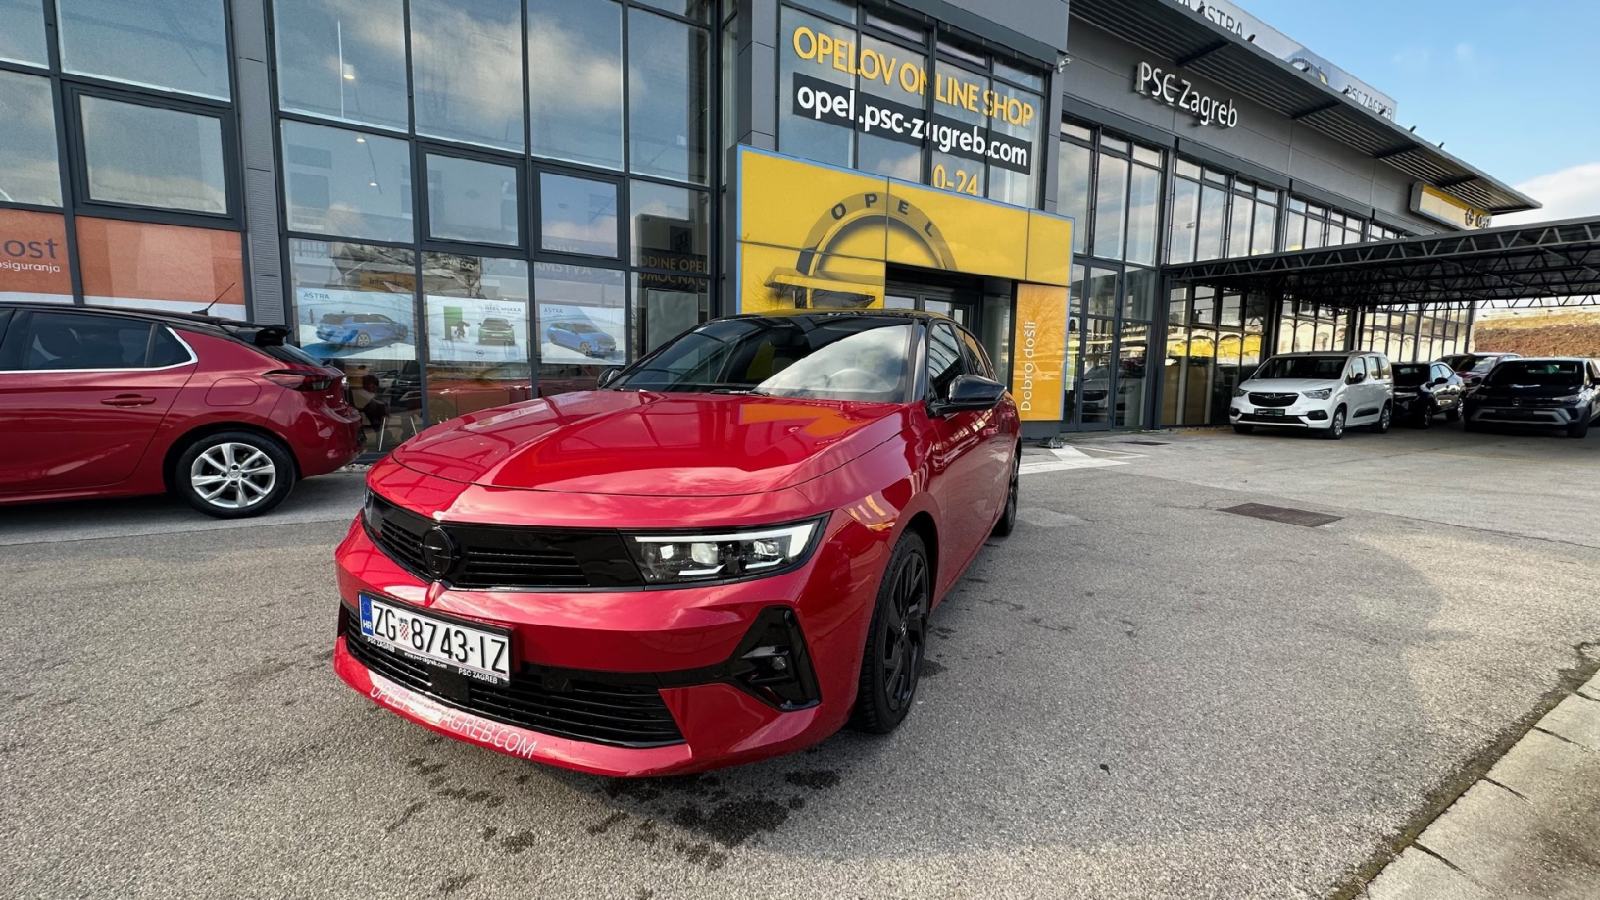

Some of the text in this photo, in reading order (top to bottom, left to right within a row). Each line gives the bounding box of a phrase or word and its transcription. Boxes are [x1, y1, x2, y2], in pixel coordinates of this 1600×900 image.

[793, 26, 897, 86] OPELOV
[982, 89, 1034, 127] SHOP
[797, 86, 1028, 167] opel.psc-zagreb.com
[932, 164, 978, 196] 0-24
[831, 193, 933, 239] OPEL
[303, 291, 330, 300] ASTRA
[1021, 321, 1037, 411] Dobro došli
[362, 619, 373, 631] HR
[373, 604, 396, 641] ZG
[458, 667, 498, 684] PSC ZAGREB
